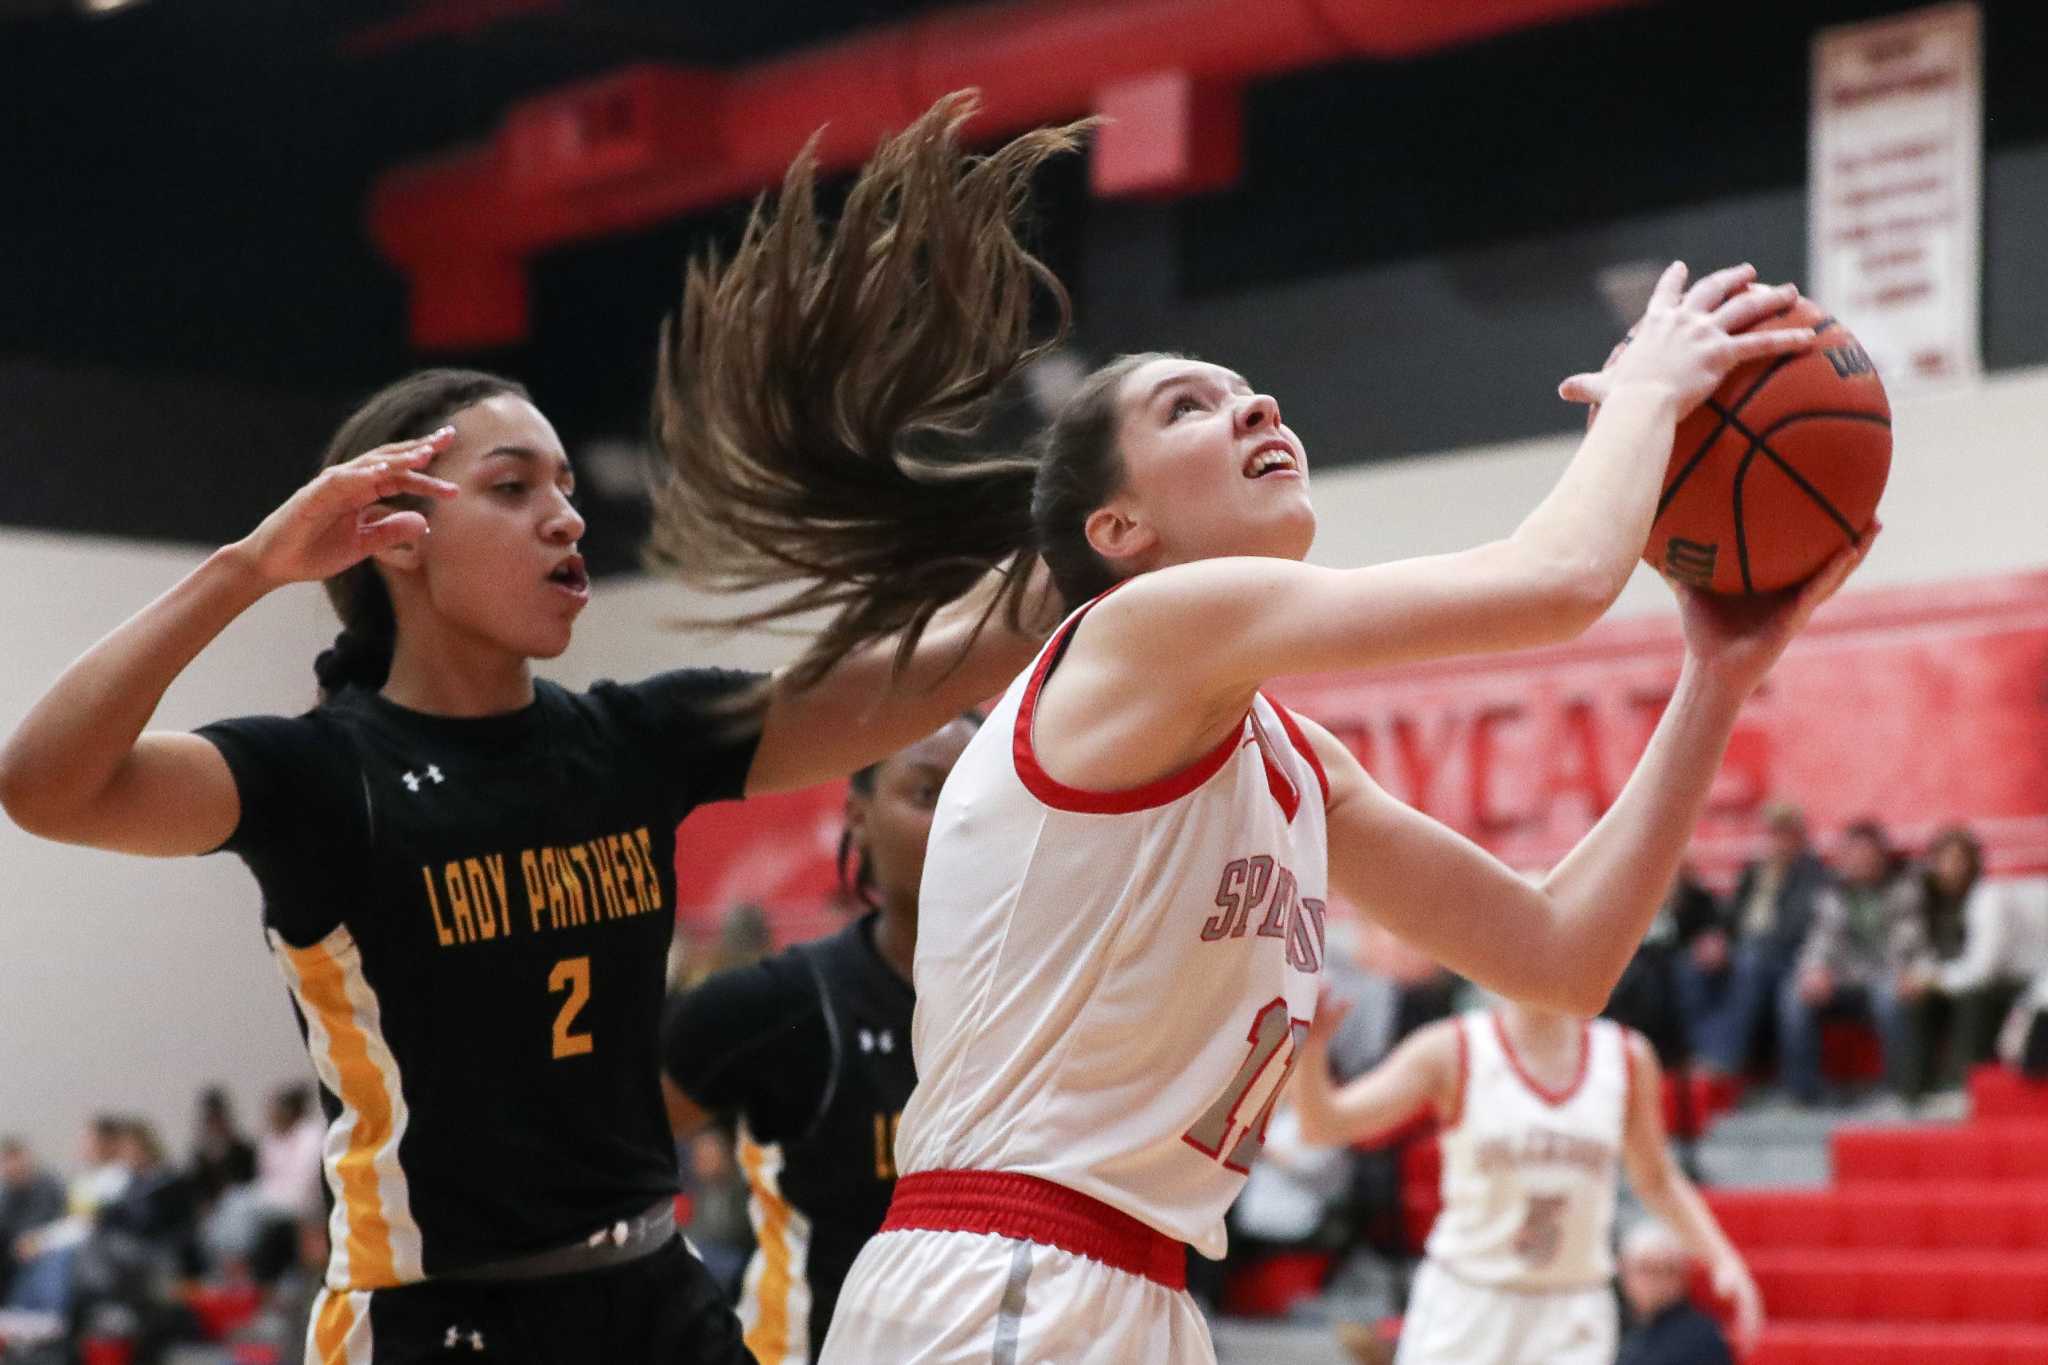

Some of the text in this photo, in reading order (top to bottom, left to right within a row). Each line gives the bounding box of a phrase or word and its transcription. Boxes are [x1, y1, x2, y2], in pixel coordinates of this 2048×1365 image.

[422, 826, 662, 946] LADY PANTHERS
[548, 956, 593, 1060] 2
